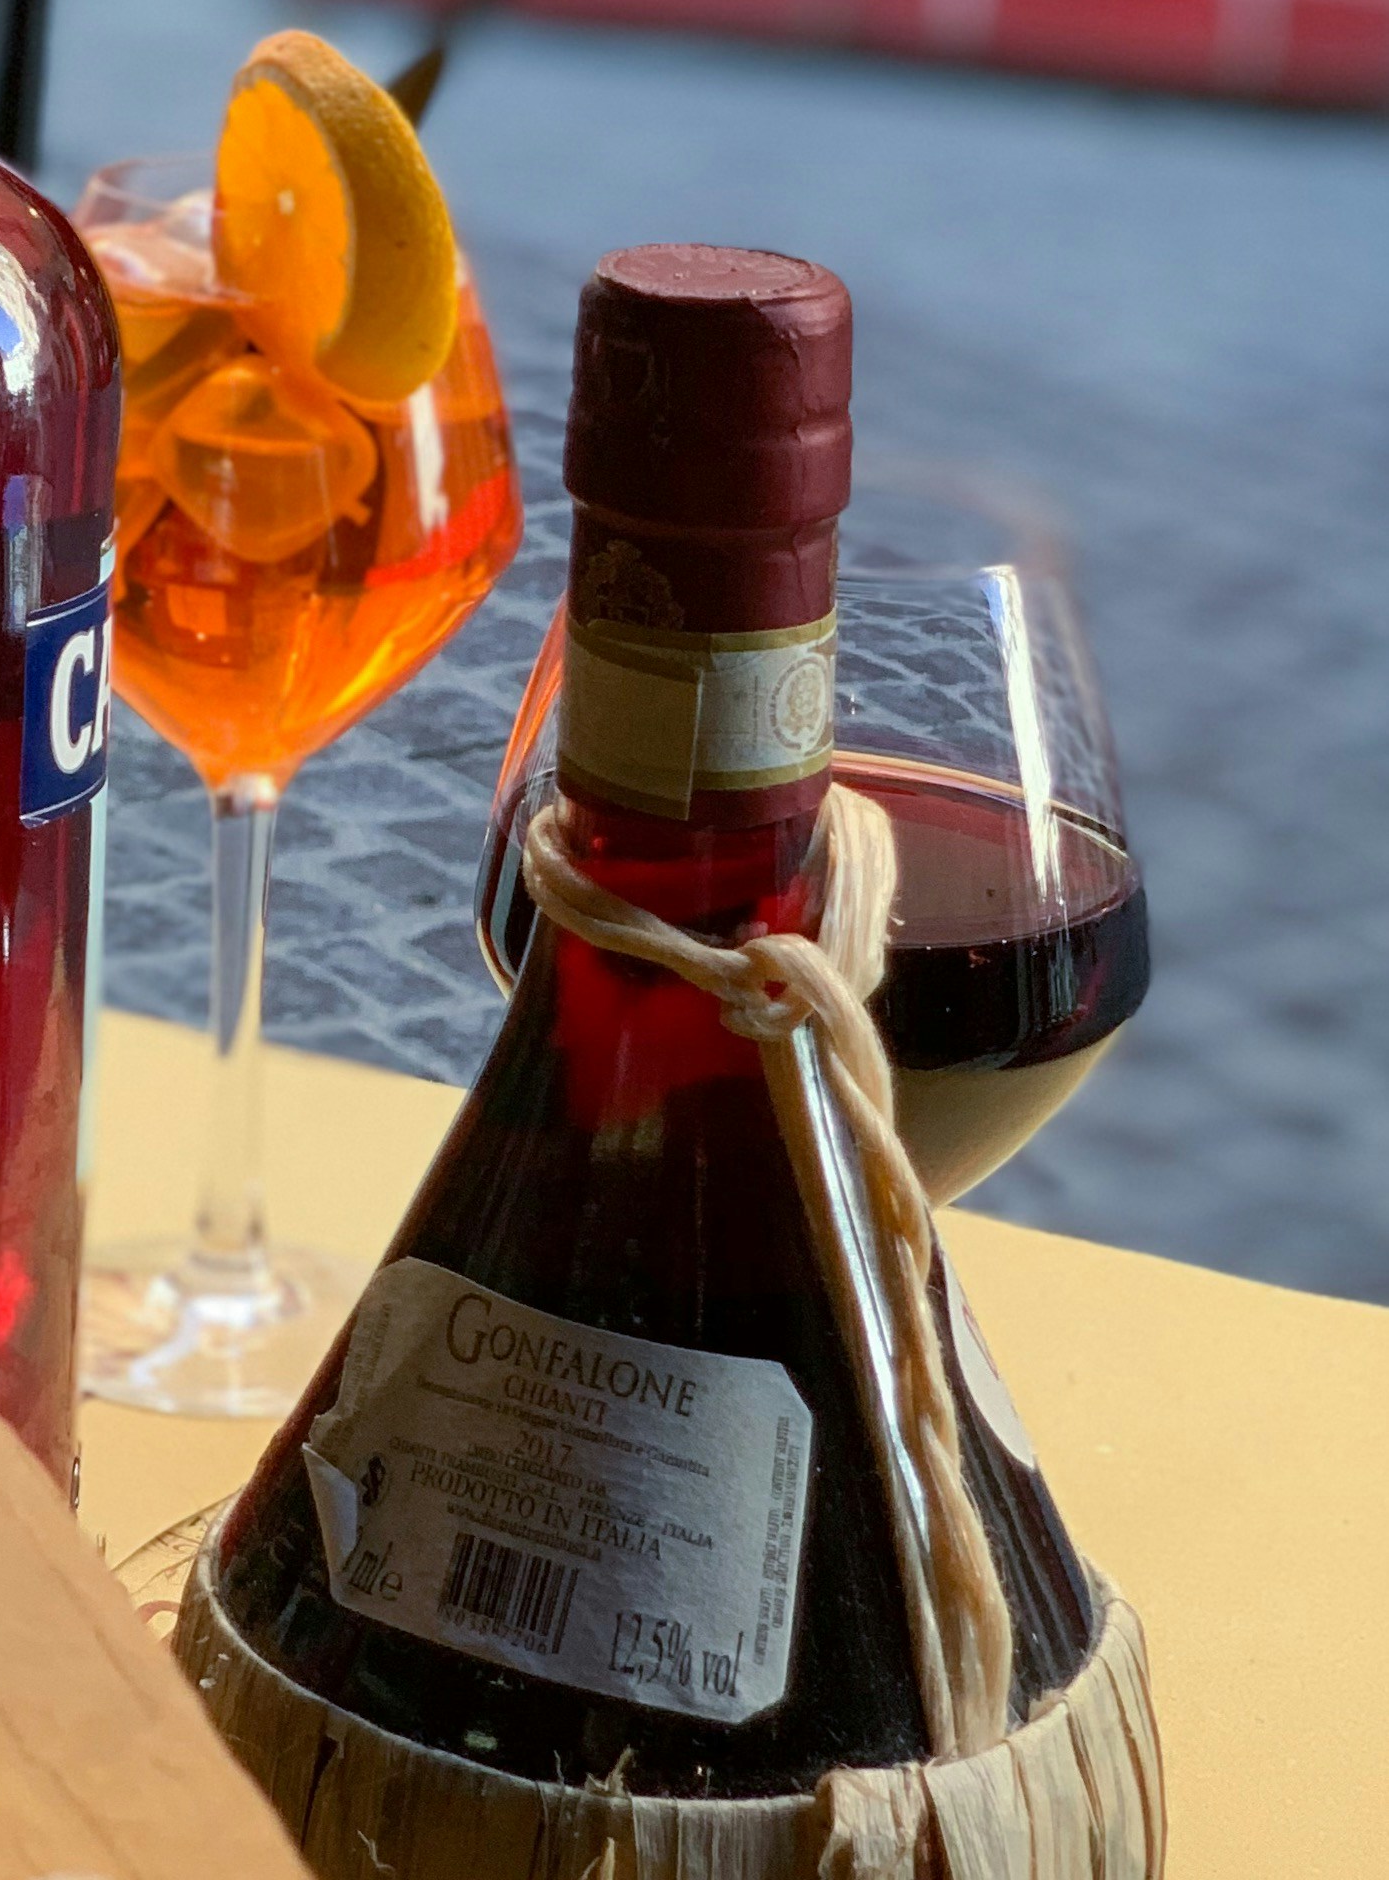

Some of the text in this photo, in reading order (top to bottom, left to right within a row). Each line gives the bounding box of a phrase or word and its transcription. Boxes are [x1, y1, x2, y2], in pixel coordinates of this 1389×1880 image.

[518, 1430, 573, 1465] 2017
[409, 1462, 661, 1559] PRODOTTO IN ITALIA
